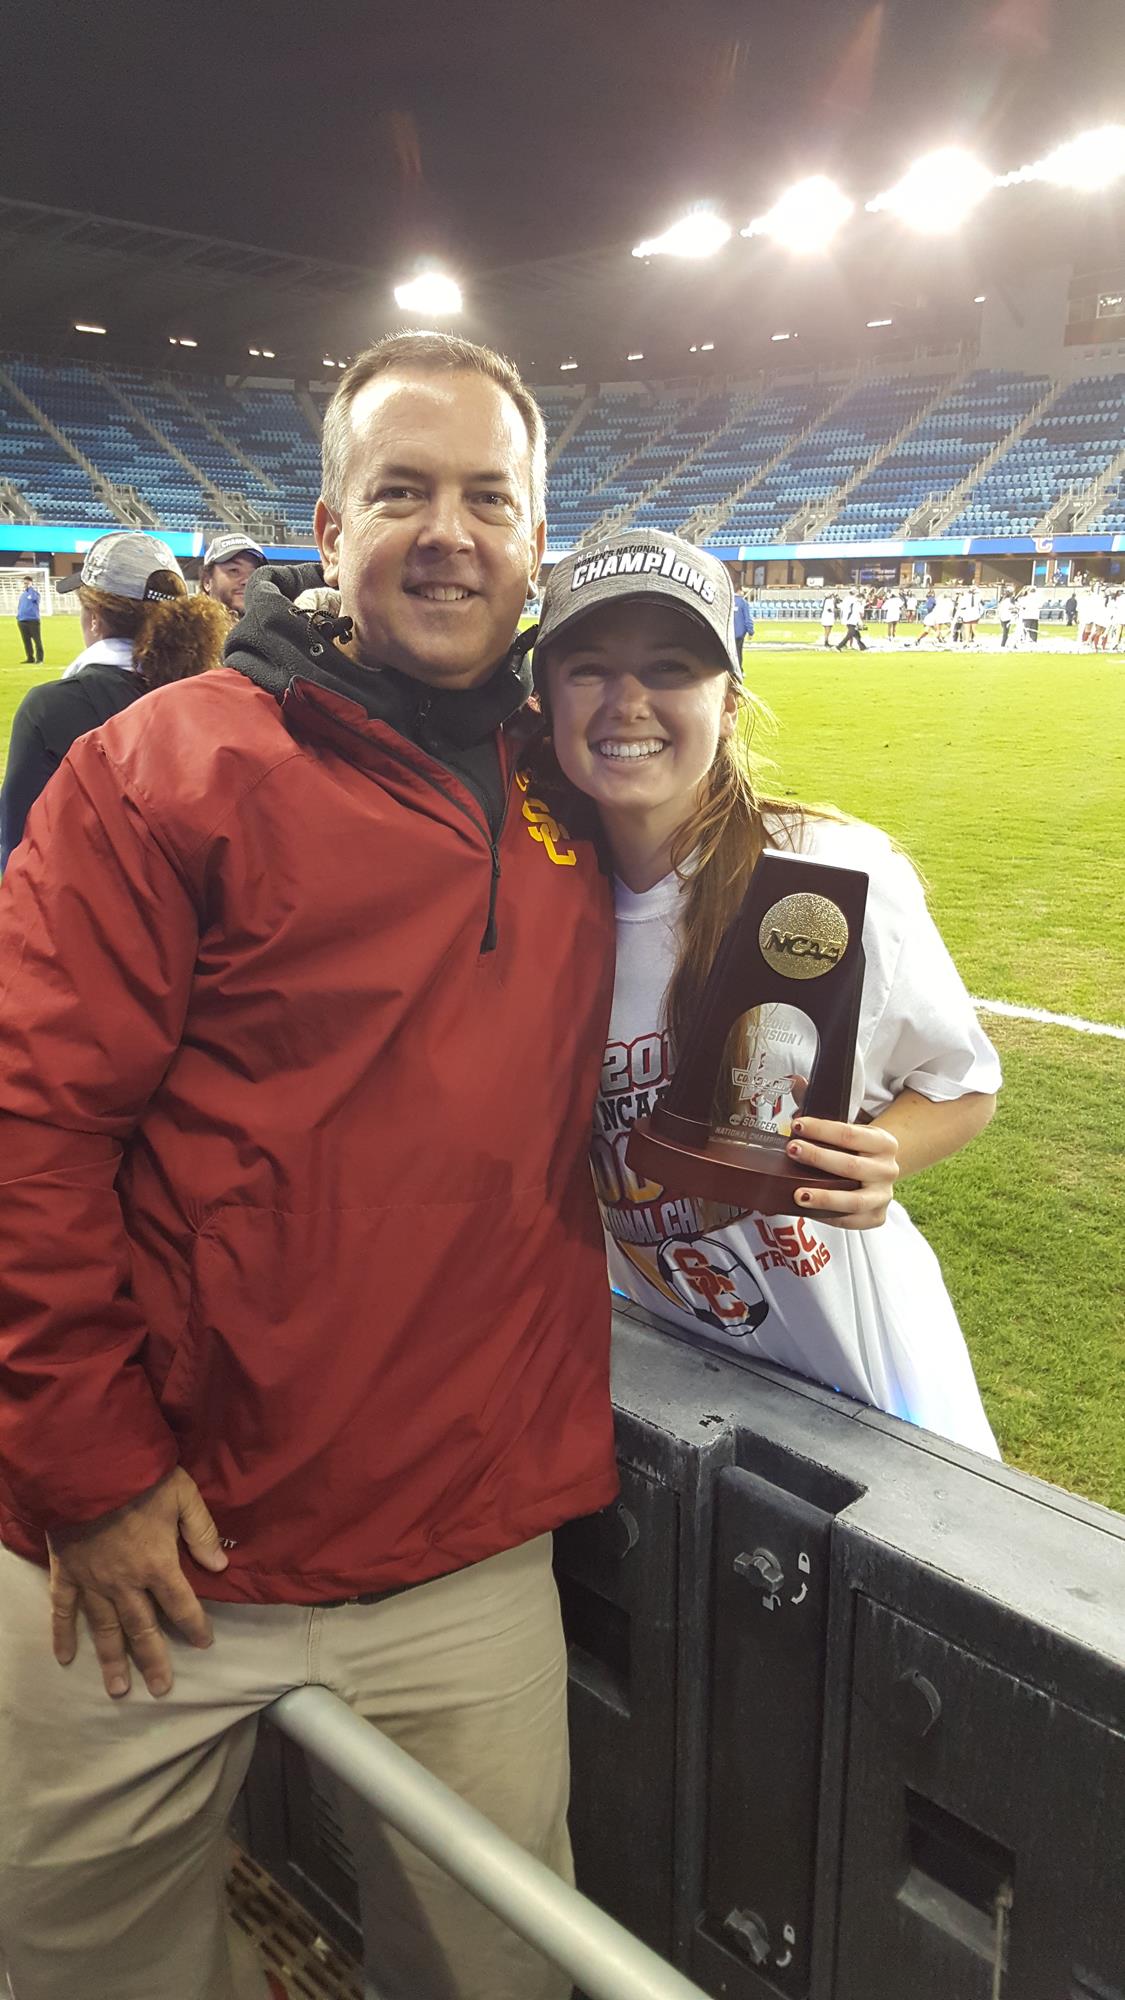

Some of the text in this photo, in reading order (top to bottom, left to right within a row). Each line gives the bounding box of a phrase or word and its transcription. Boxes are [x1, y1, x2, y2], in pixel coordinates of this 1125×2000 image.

[577, 544, 610, 563] NCAA
[615, 545, 661, 556] NATIONAL
[762, 927, 843, 963] NCAA
[742, 1117, 777, 1132] SOCCER
